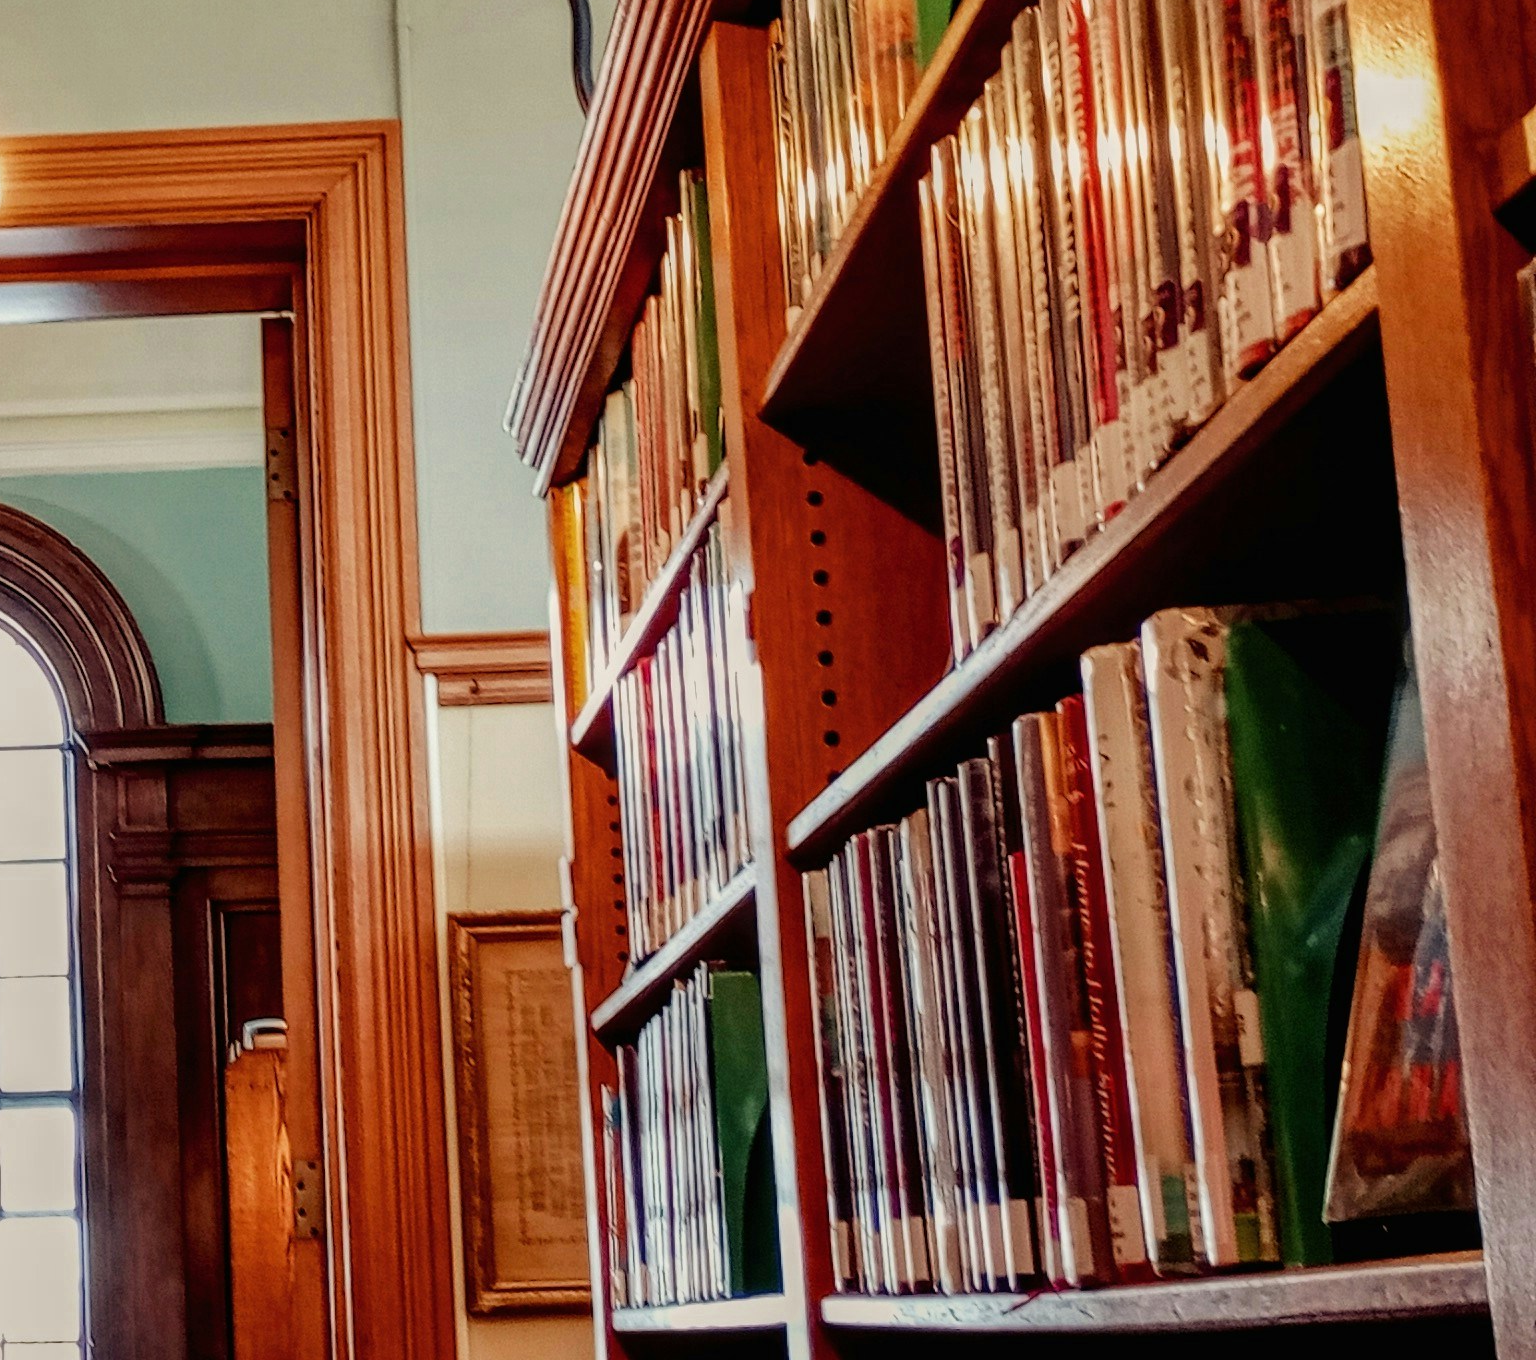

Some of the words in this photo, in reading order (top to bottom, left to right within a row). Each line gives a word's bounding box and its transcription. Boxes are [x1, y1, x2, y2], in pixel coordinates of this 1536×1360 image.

[1073, 840, 1092, 927] Home
[1083, 942, 1095, 971] to
[1085, 978, 1109, 1060] Holly
